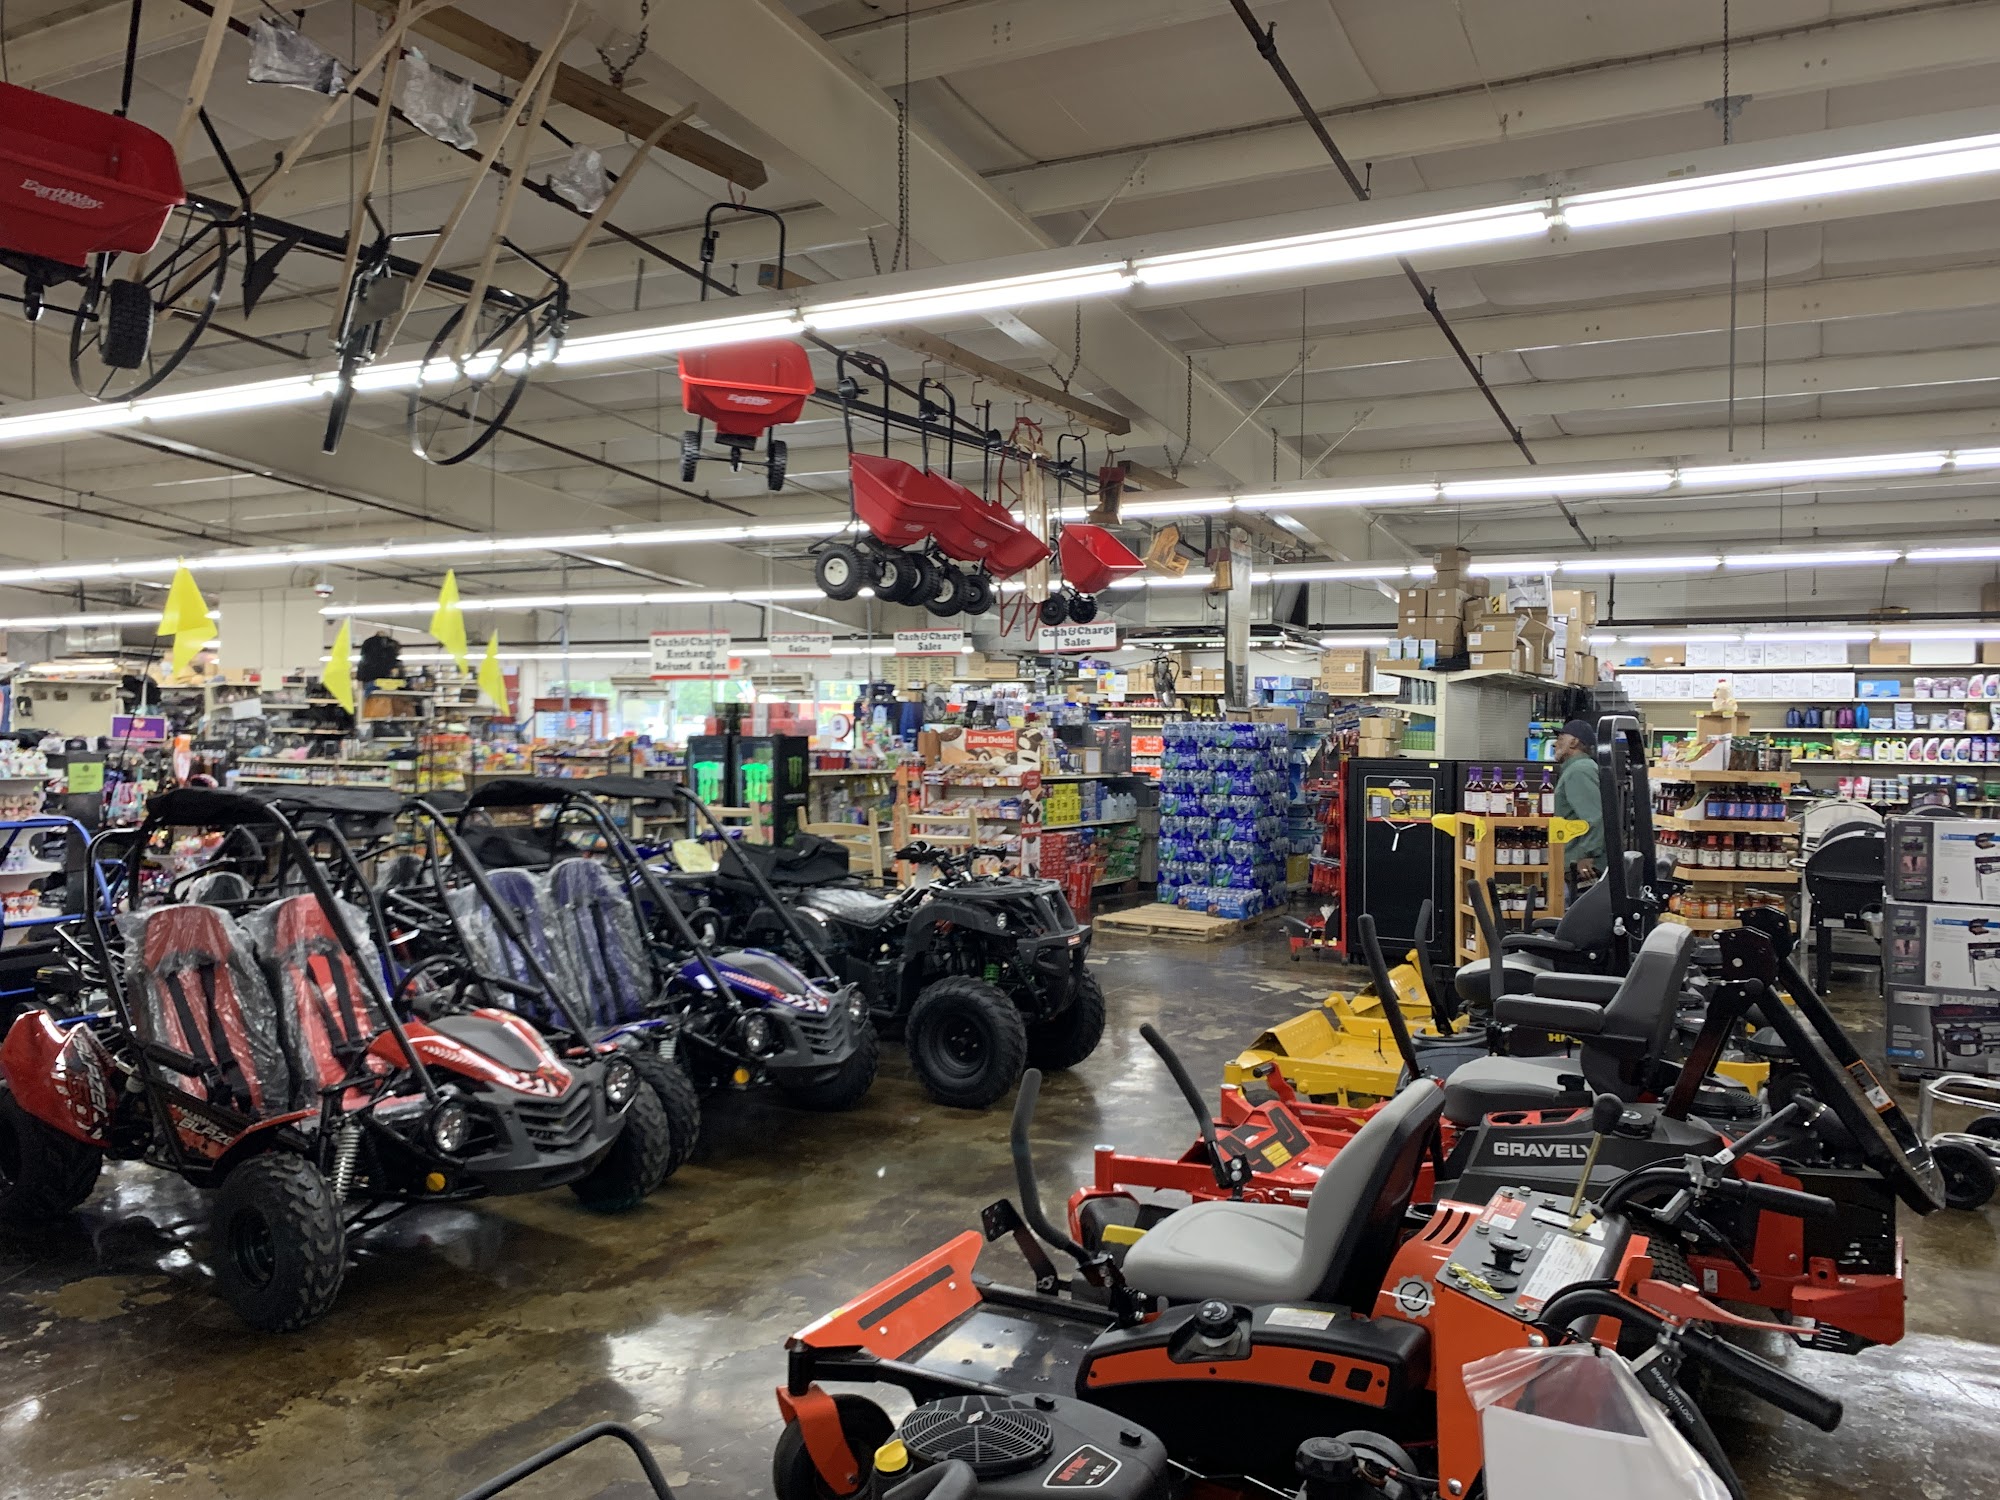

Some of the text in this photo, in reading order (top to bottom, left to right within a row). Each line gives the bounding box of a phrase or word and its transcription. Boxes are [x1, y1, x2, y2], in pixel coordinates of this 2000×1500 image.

[917, 642, 942, 651] Sales
[1064, 637, 1091, 647] Sales
[667, 649, 716, 659] Exchange
[788, 645, 810, 653] Sales
[655, 661, 726, 671] Refund Sales
[968, 735, 1014, 744] Little Debbie
[1650, 1367, 1696, 1424] BRAKE WITH LOCK
